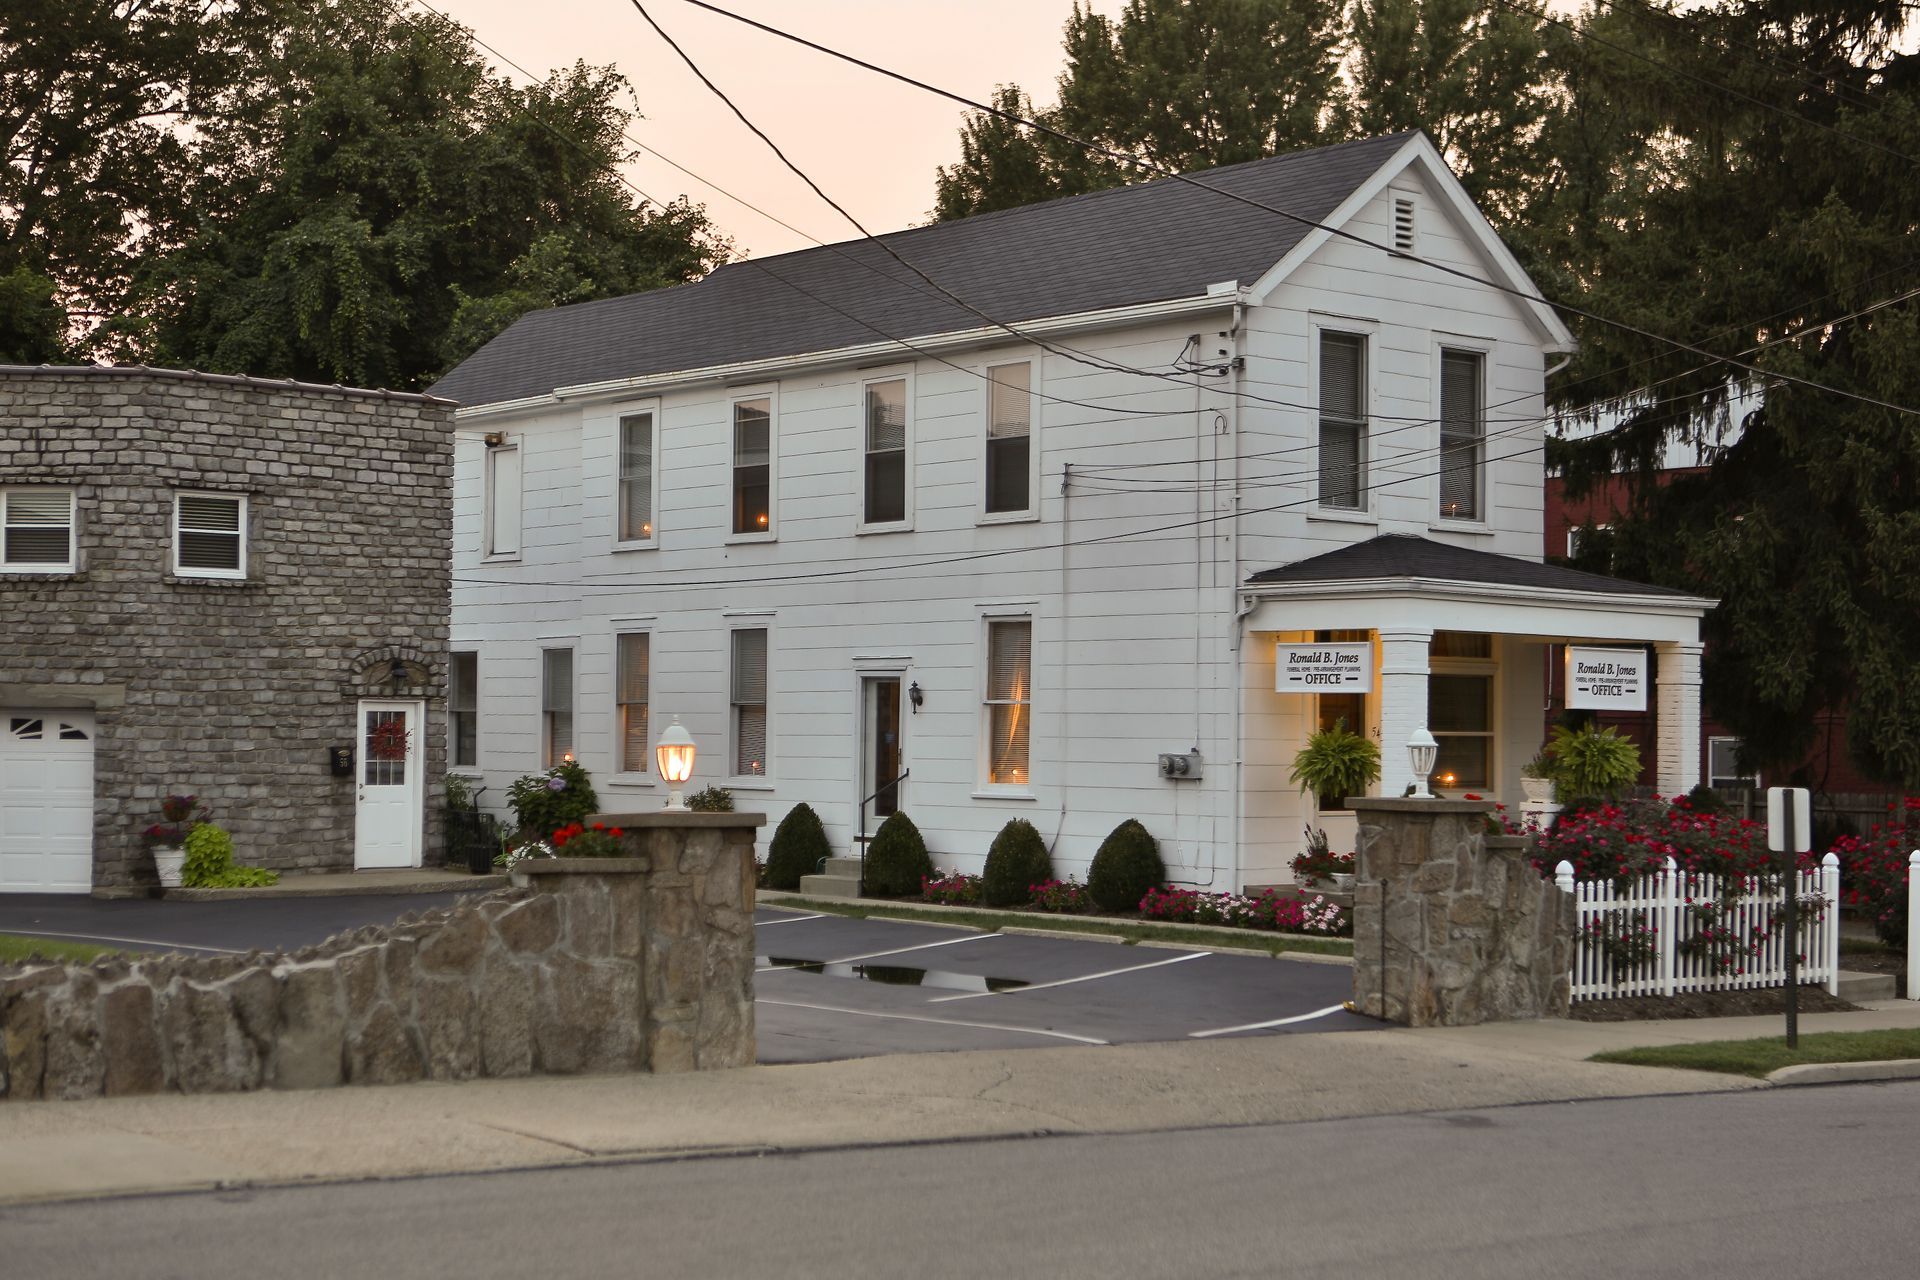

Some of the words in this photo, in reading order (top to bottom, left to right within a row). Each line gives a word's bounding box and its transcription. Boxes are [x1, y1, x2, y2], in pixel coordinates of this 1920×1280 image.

[1289, 652, 1321, 663] Ronald
[1323, 652, 1332, 663] B.
[1334, 652, 1359, 665] Jones
[1577, 662, 1605, 674] Ronald
[1606, 663, 1614, 675] B.
[1616, 664, 1636, 677] Jones
[1305, 673, 1341, 684] OFFICE
[1592, 684, 1622, 696] OFFICE
